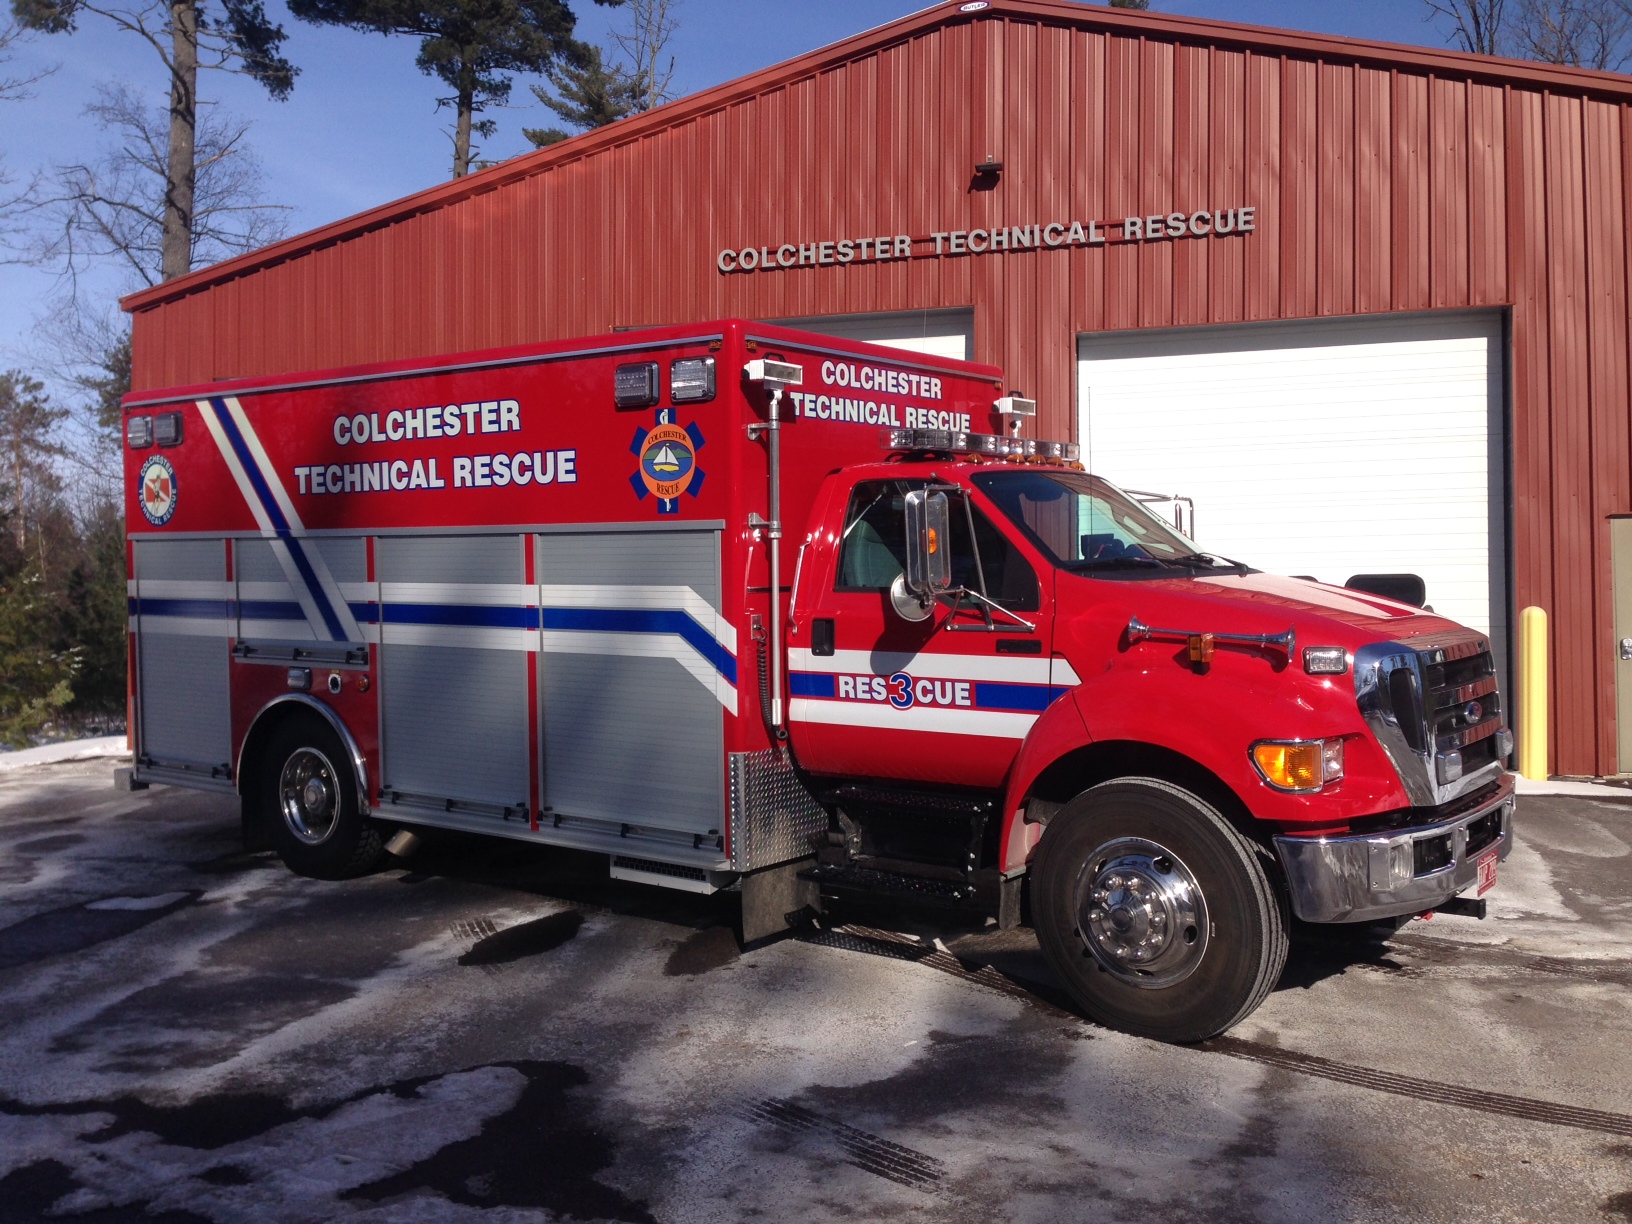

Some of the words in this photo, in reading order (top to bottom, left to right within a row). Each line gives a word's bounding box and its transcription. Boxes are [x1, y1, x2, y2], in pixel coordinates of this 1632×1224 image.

[717, 235, 911, 271] COLCHESTER
[931, 220, 1105, 255] TECHNICAL
[1124, 207, 1256, 240] RESCUE
[821, 360, 942, 399] COLCHESTER
[333, 399, 521, 445] COLCHESTER
[789, 391, 900, 427] TECHNICAL
[905, 406, 971, 433] RESCUE
[648, 431, 687, 445] COLCHESTER
[141, 455, 173, 476] COLCHESTER
[294, 457, 445, 495] TECHNICAL
[453, 449, 577, 488] RESCUE
[139, 489, 162, 525] TECHNICAL
[162, 488, 177, 523] RESCUE
[656, 482, 680, 495] RESCUE
